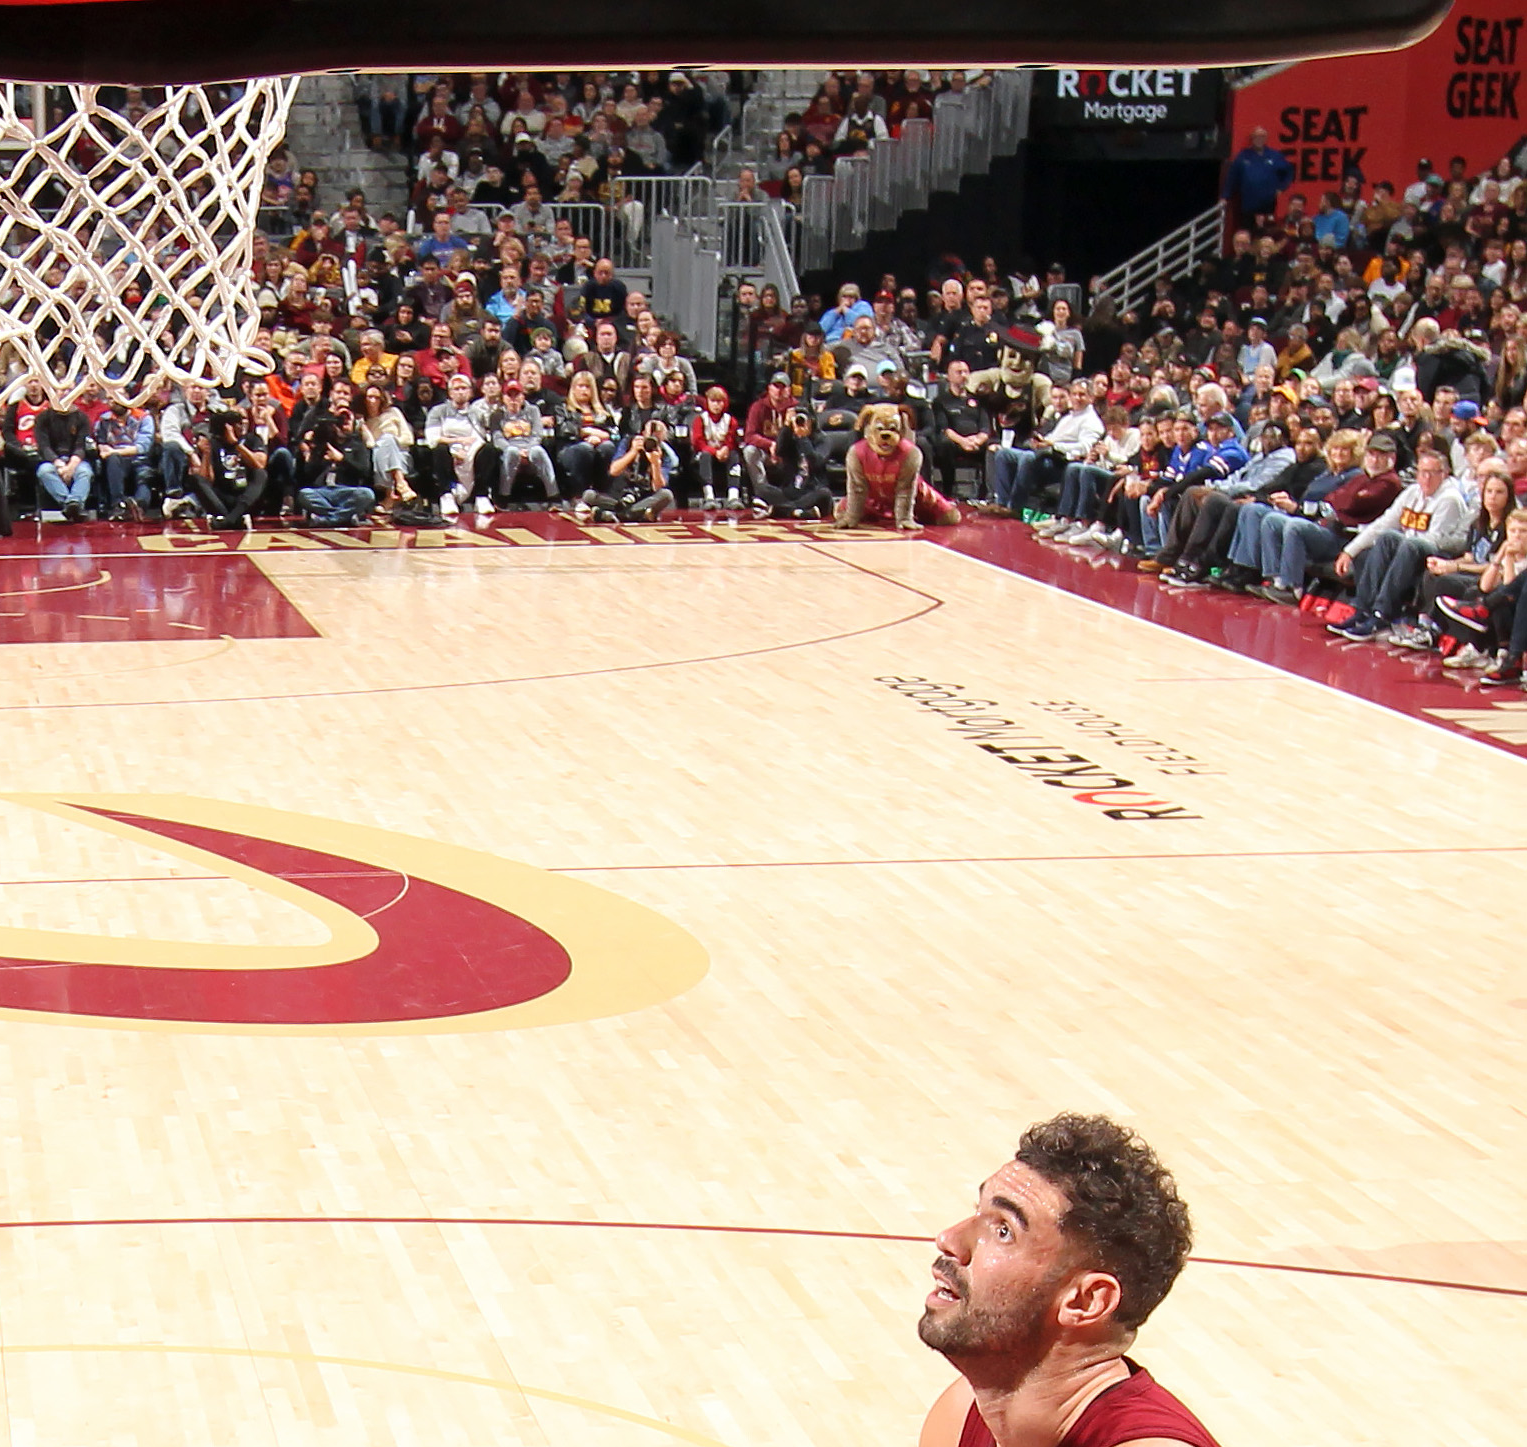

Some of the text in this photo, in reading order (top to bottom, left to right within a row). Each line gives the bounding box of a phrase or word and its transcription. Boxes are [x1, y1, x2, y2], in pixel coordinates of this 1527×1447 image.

[1455, 16, 1524, 65] SEAT
[1057, 69, 1199, 98] ROCKET
[1446, 72, 1521, 119] GEEK
[1084, 101, 1168, 124] Mortgage
[1279, 106, 1369, 143] SEAT
[137, 524, 908, 552] CAVALIERS
[873, 676, 1205, 820] ROCKET Mortgage
[1028, 701, 1228, 775] FIELDHOUSE
